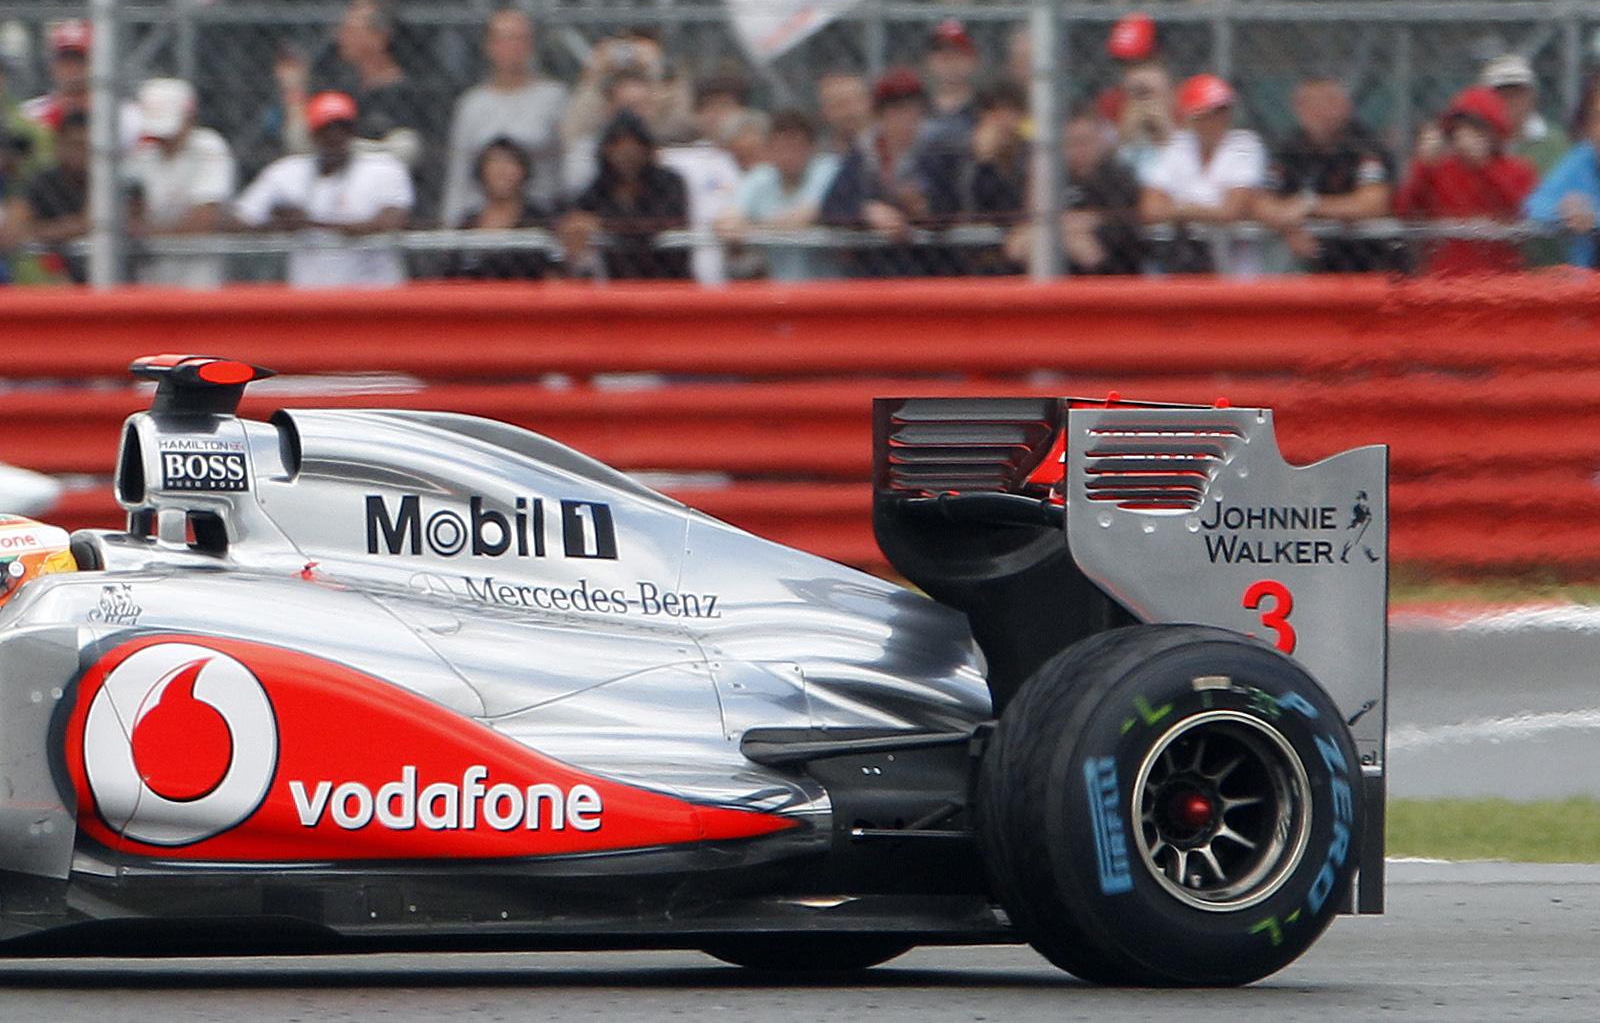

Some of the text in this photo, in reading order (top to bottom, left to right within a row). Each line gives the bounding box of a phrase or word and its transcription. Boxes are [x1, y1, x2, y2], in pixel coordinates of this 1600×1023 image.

[159, 440, 228, 450] HAMILTON
[164, 454, 244, 480] BOSS
[365, 495, 547, 558] Mobil
[1201, 501, 1338, 530] JOHNNIE
[1204, 535, 1335, 564] WALKER
[460, 576, 722, 619] Mercedes-Benz
[1242, 579, 1297, 656] 3
[289, 765, 602, 831] vodafone
